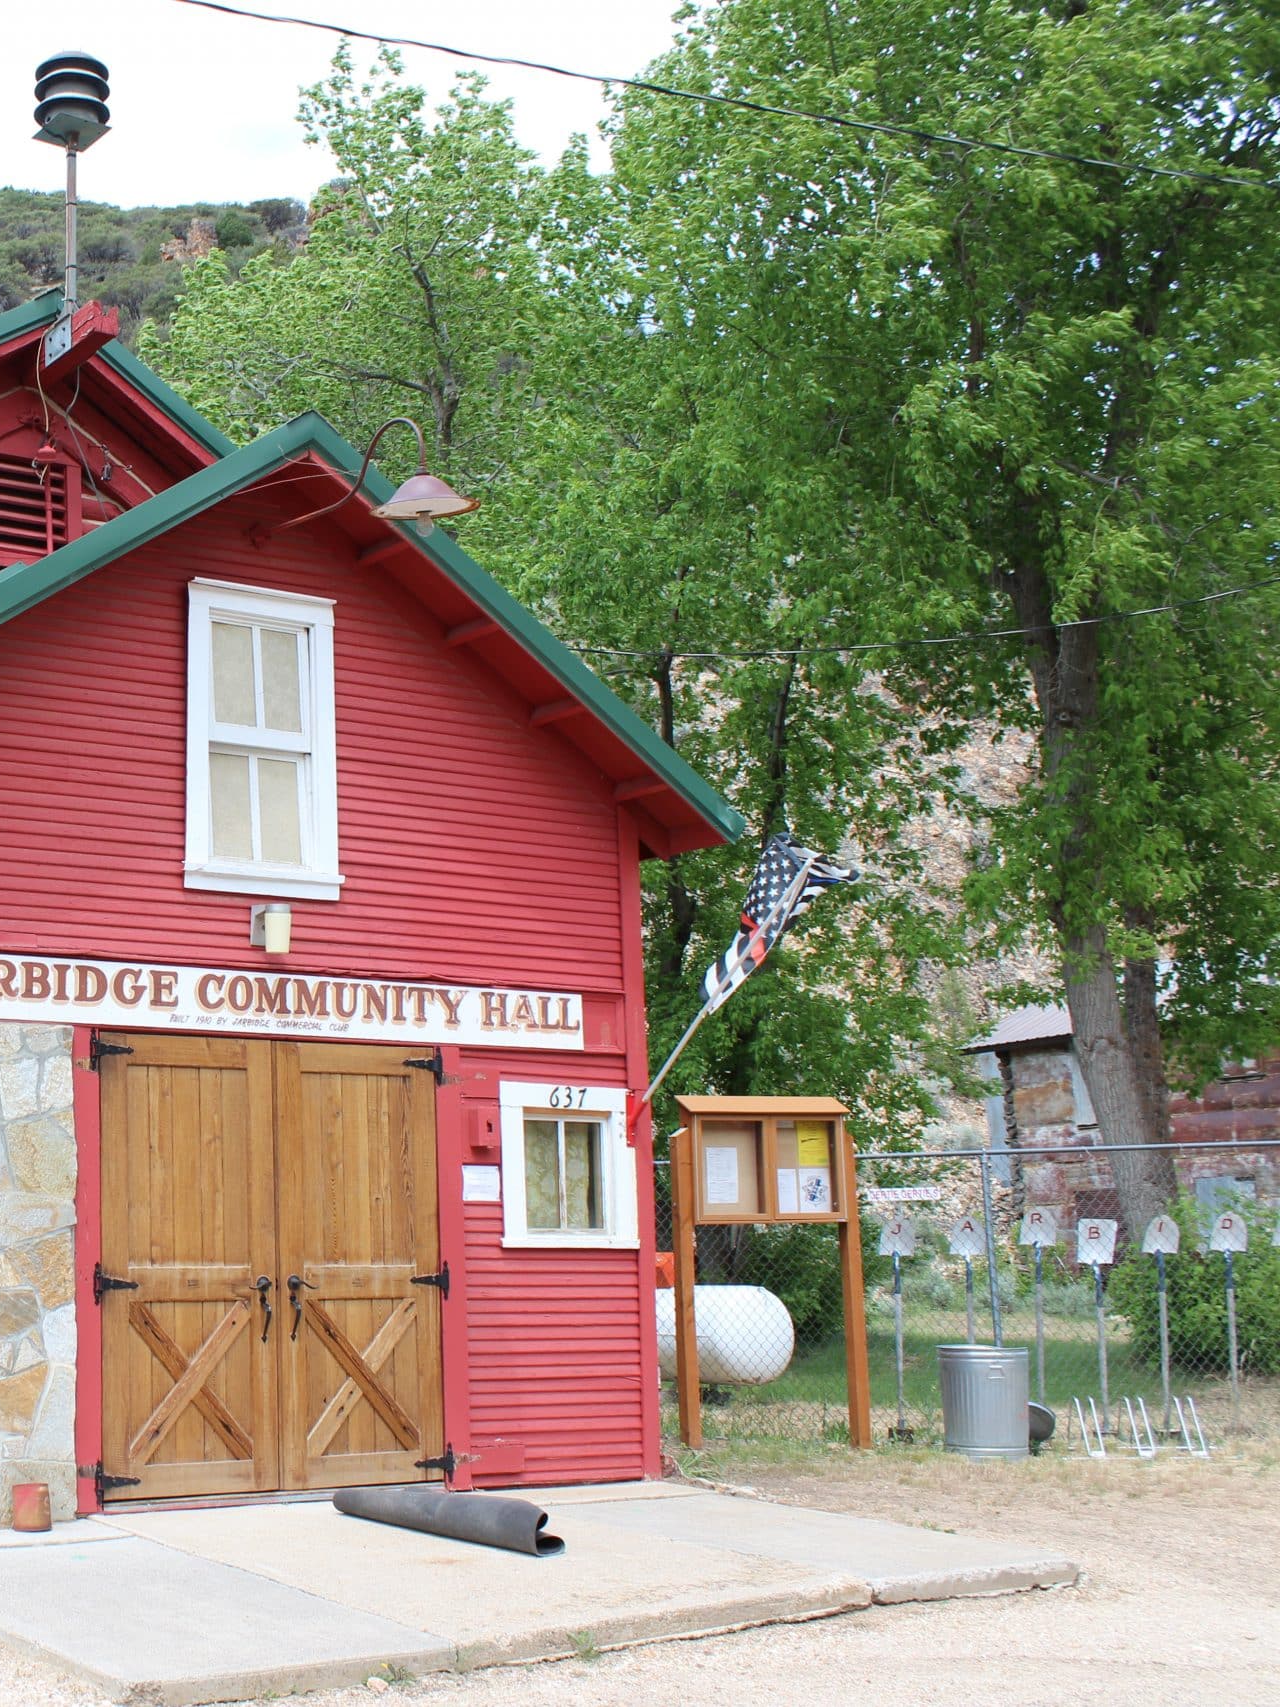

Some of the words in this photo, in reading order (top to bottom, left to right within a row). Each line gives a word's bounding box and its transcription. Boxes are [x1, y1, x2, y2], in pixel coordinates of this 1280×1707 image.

[195, 974, 468, 1028] COMMUNITY
[480, 991, 581, 1034] HALL
[196, 1016, 213, 1026] 1910
[216, 1017, 229, 1026] BY
[232, 1018, 270, 1029] JARBIDGE
[276, 1019, 322, 1031] COMMERCIAL
[328, 1023, 350, 1032] CLUB
[549, 1086, 587, 1108] 637
[891, 1223, 902, 1235] J
[961, 1220, 974, 1232] A
[1030, 1212, 1042, 1224] R
[1088, 1226, 1100, 1240] B
[1221, 1218, 1233, 1229] D
